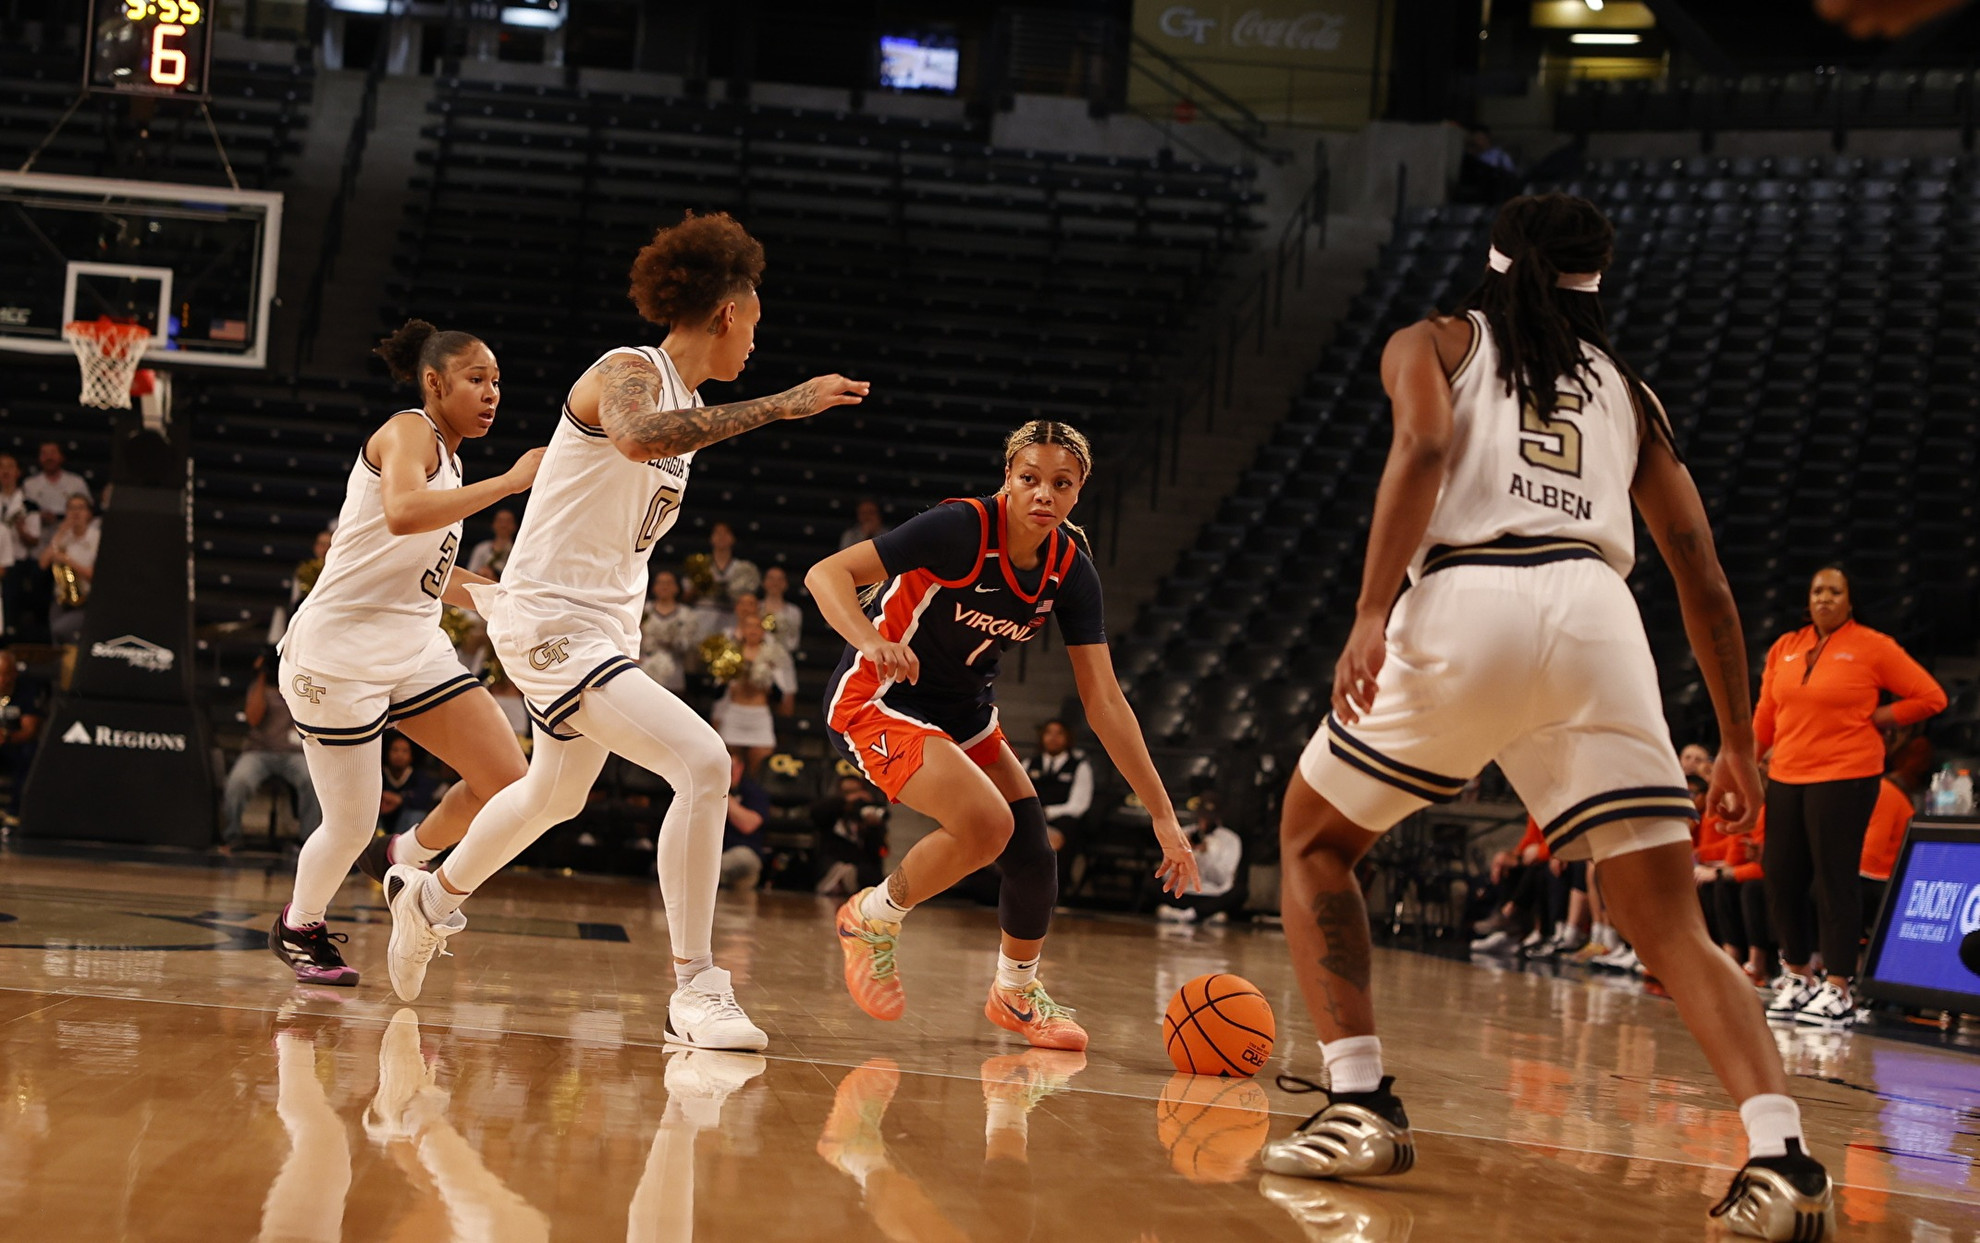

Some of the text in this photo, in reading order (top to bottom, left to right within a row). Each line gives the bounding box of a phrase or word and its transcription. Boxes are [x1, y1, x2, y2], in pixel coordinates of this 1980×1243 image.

[150, 22, 187, 86] 6
[1519, 390, 1583, 479] 5
[1509, 473, 1592, 520] ALBEN
[635, 485, 680, 553] 0
[420, 531, 458, 600] 3
[954, 601, 1037, 642] VIRGINI
[529, 637, 570, 671] GT
[964, 637, 996, 667] 1
[292, 674, 326, 704] GT
[95, 724, 187, 752] REGIONS
